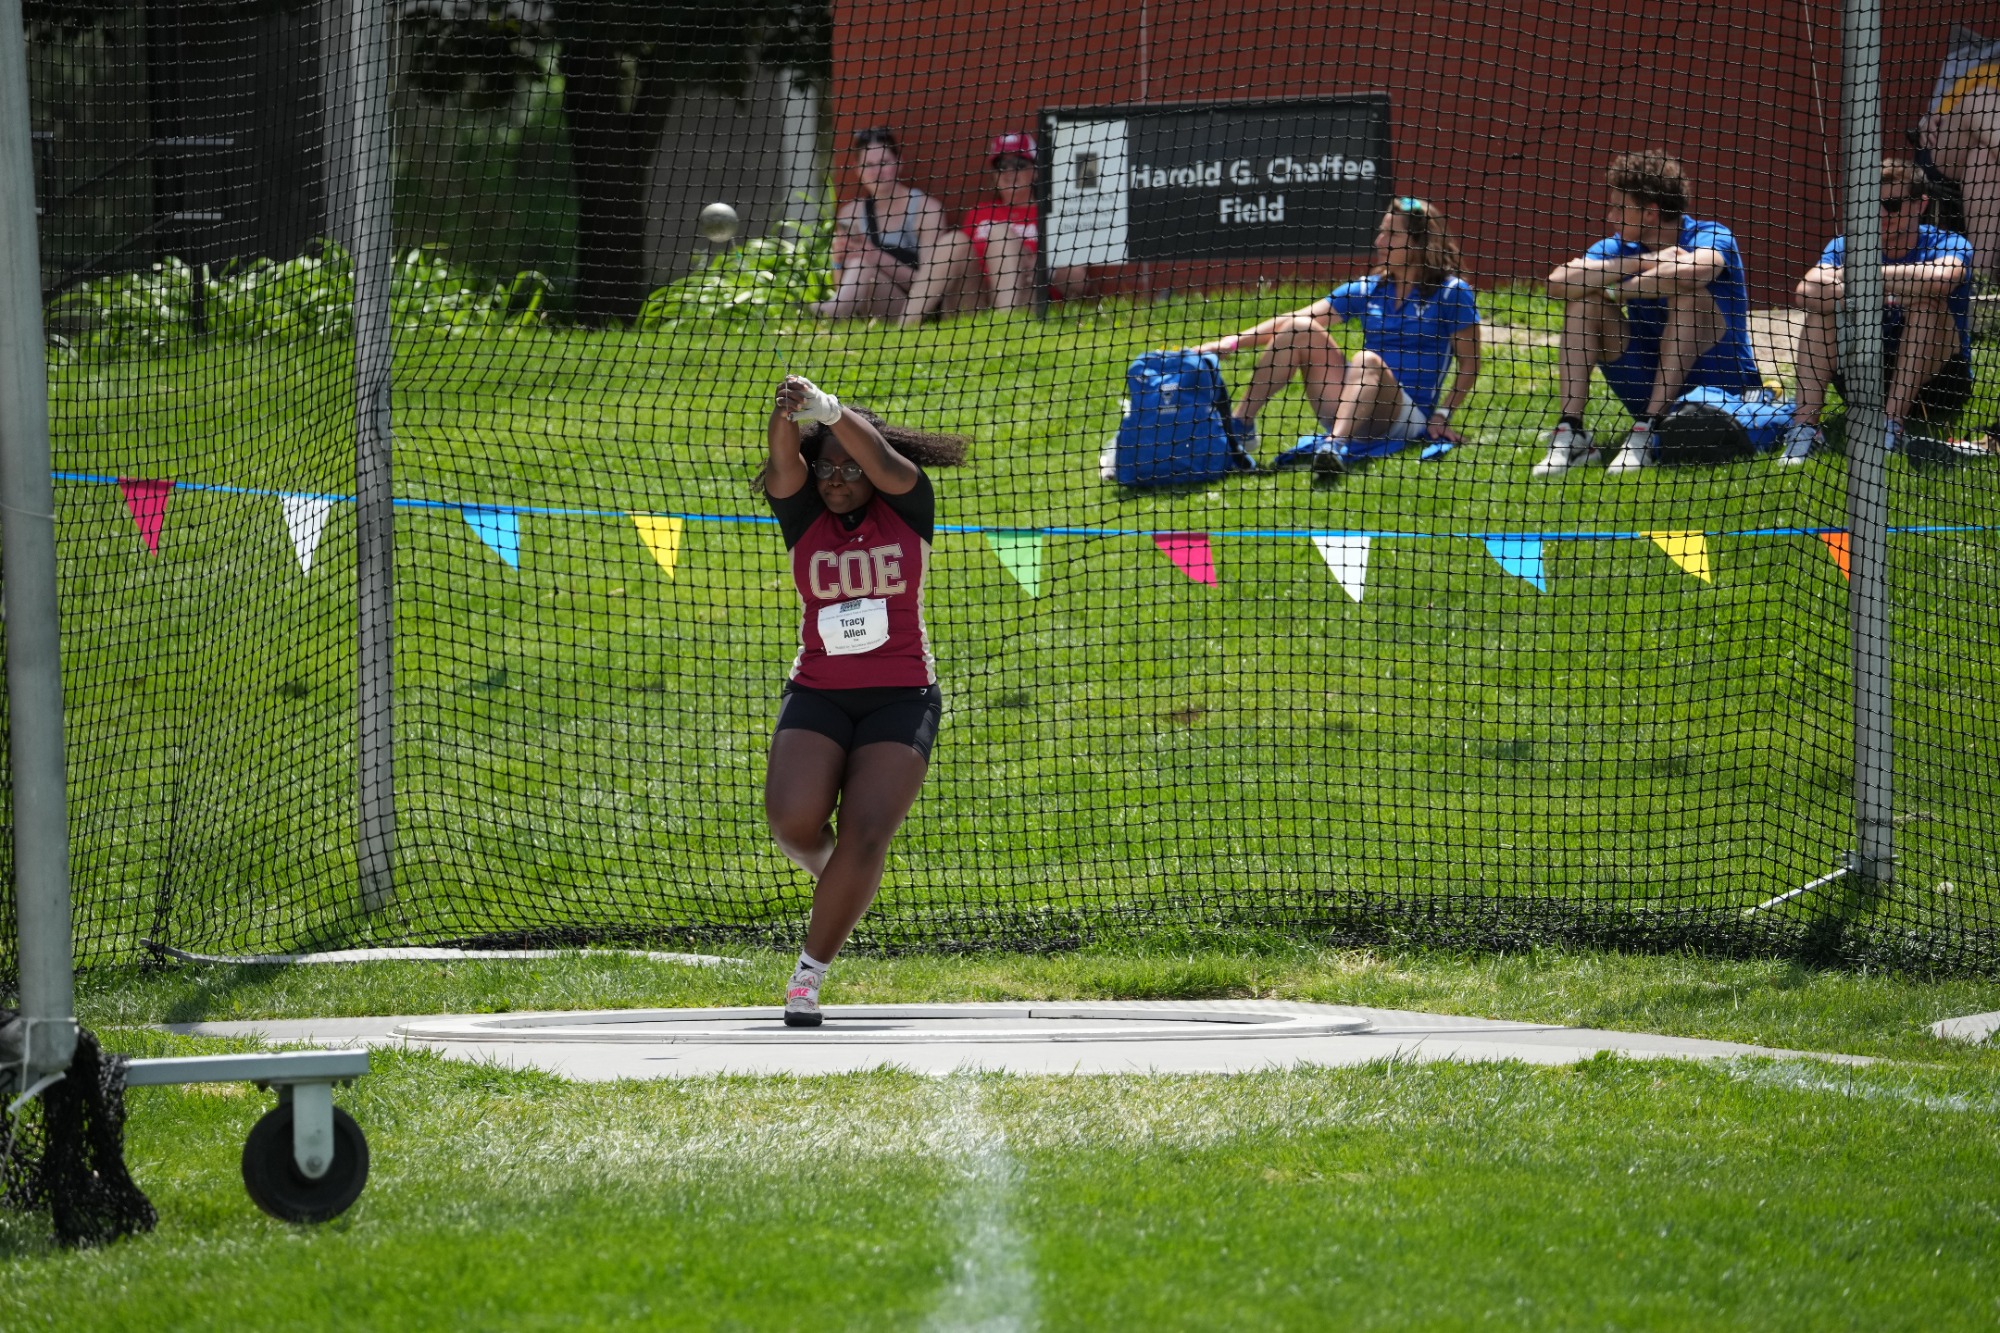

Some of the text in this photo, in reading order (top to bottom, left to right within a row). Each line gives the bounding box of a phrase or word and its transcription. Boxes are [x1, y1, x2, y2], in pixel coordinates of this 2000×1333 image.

[1130, 154, 1377, 189] Harold G. Chaffee
[1220, 195, 1284, 224] Field
[809, 543, 907, 599] COE
[839, 617, 865, 628] Tracy
[843, 629, 867, 639] Allen
[788, 987, 810, 998] NIKE
